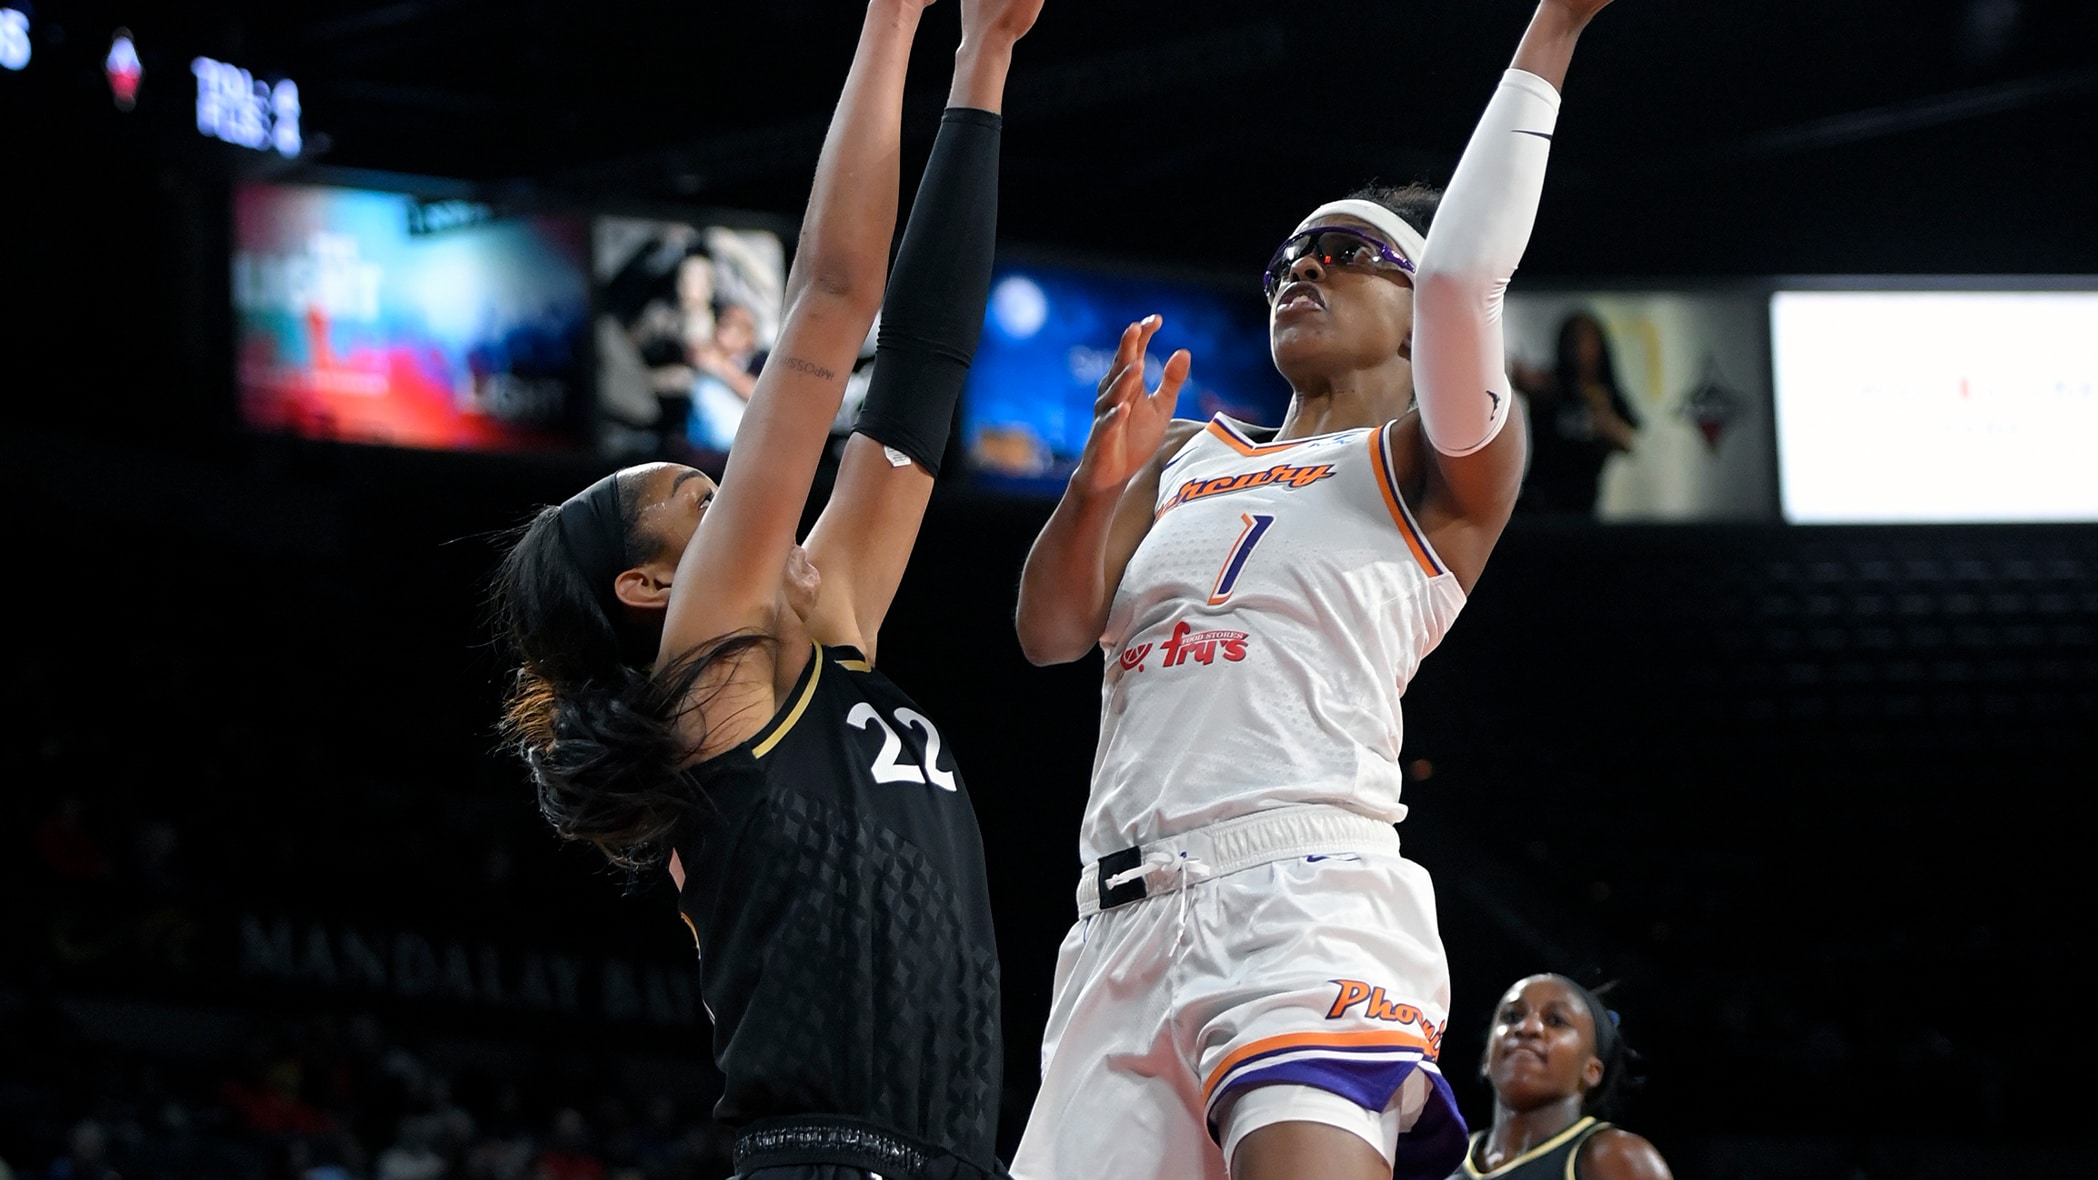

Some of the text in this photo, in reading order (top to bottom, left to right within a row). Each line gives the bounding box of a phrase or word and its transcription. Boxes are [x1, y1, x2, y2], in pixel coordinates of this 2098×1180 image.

[1153, 464, 1336, 522] ercury
[1207, 513, 1275, 606] 1
[1160, 621, 1249, 668] fry's
[1181, 630, 1244, 645] FOOD STORES
[846, 702, 957, 792] 22
[239, 911, 581, 1016] MANDALAY
